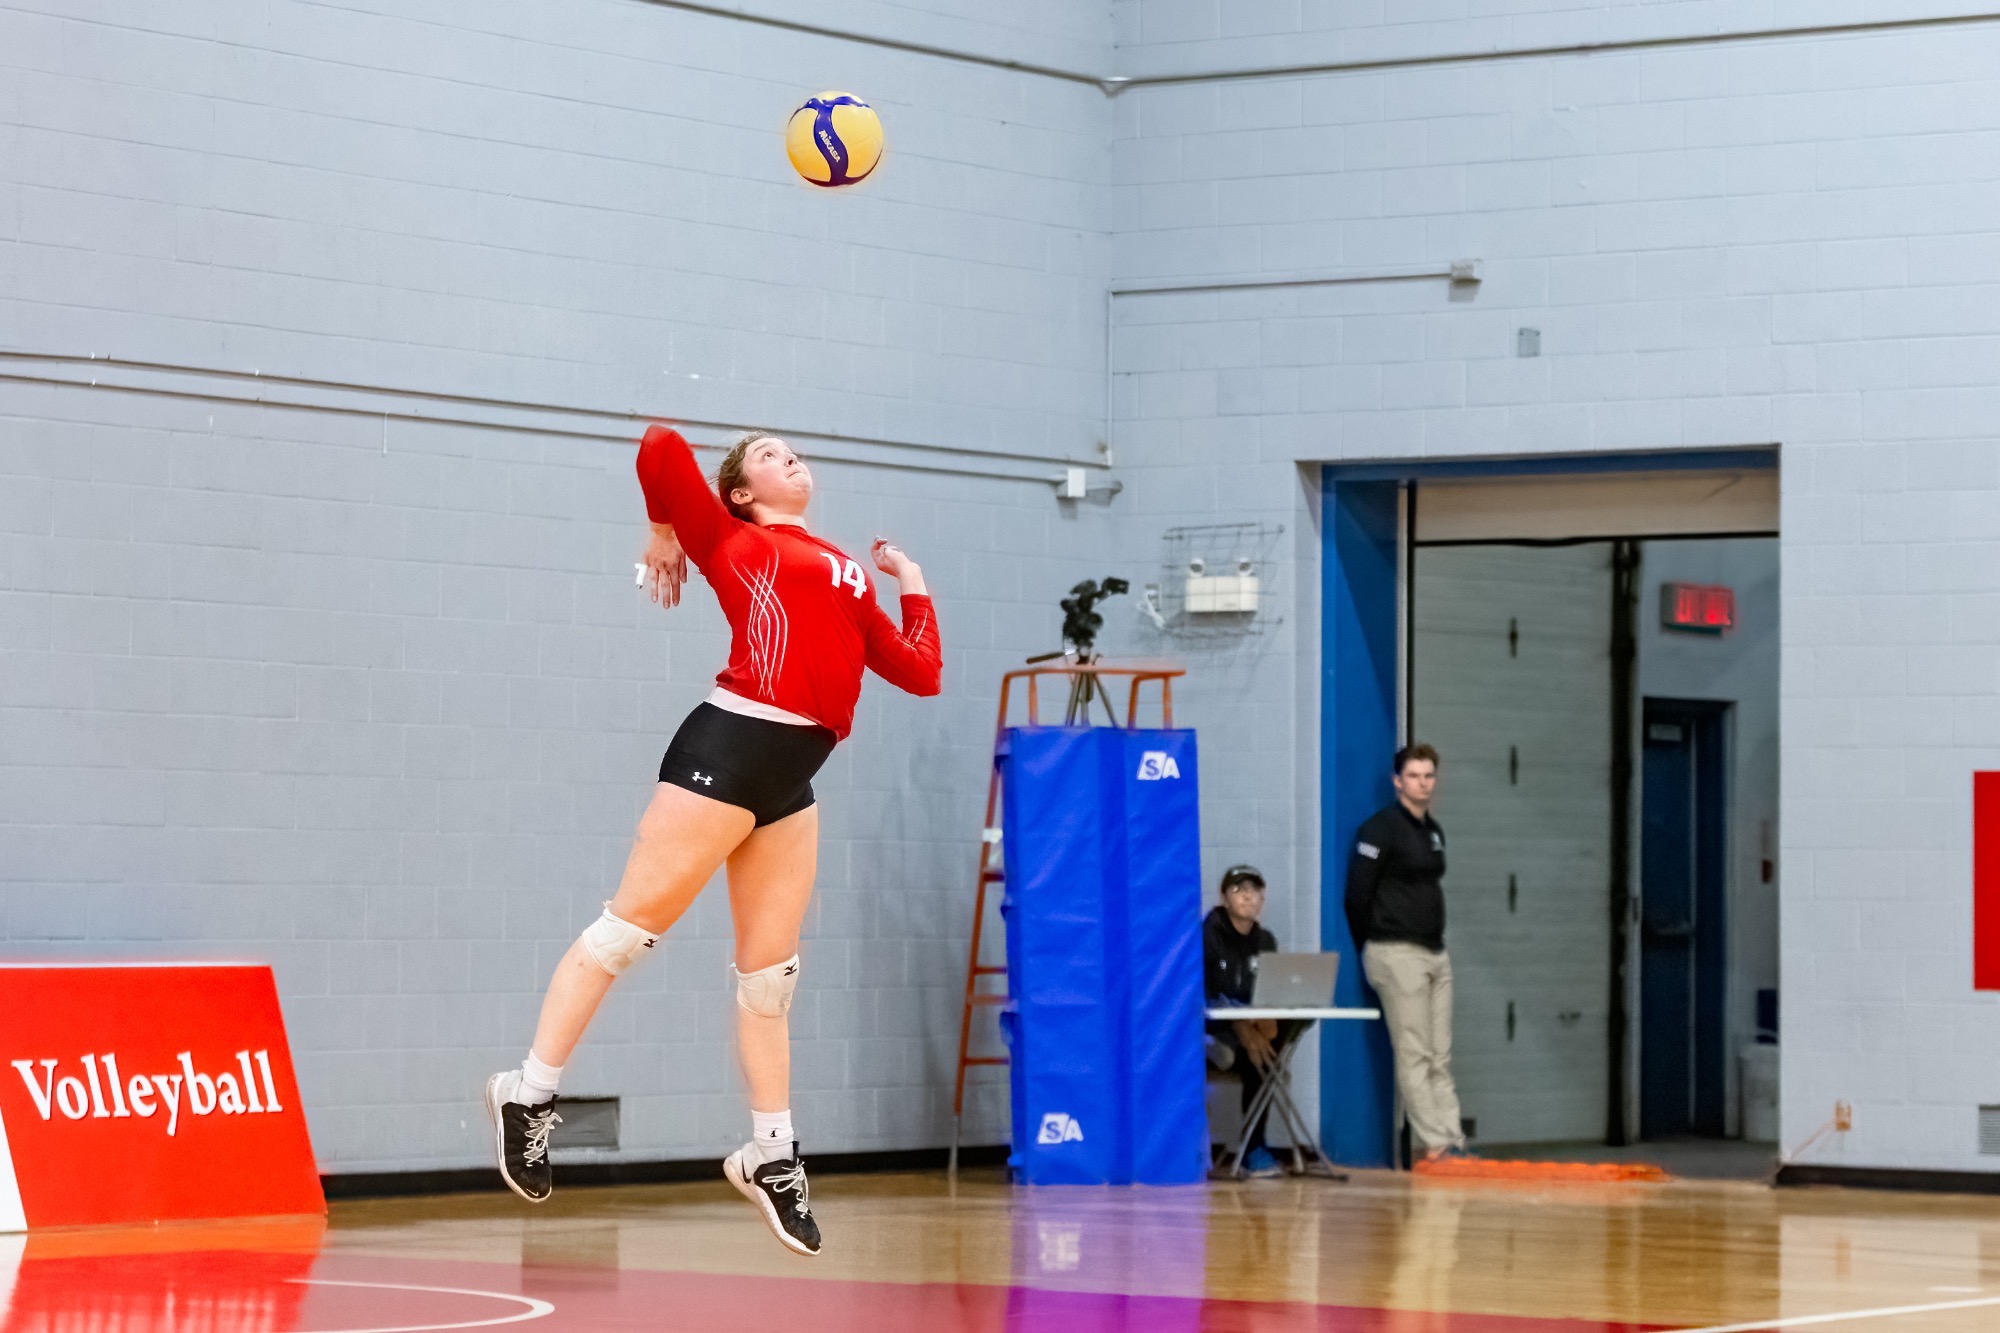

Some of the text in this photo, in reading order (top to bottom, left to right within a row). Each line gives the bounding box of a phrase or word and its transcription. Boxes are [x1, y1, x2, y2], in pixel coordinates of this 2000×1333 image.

[820, 552, 867, 600] 14
[1136, 750, 1181, 780] SA
[11, 1049, 283, 1137] Volleyball
